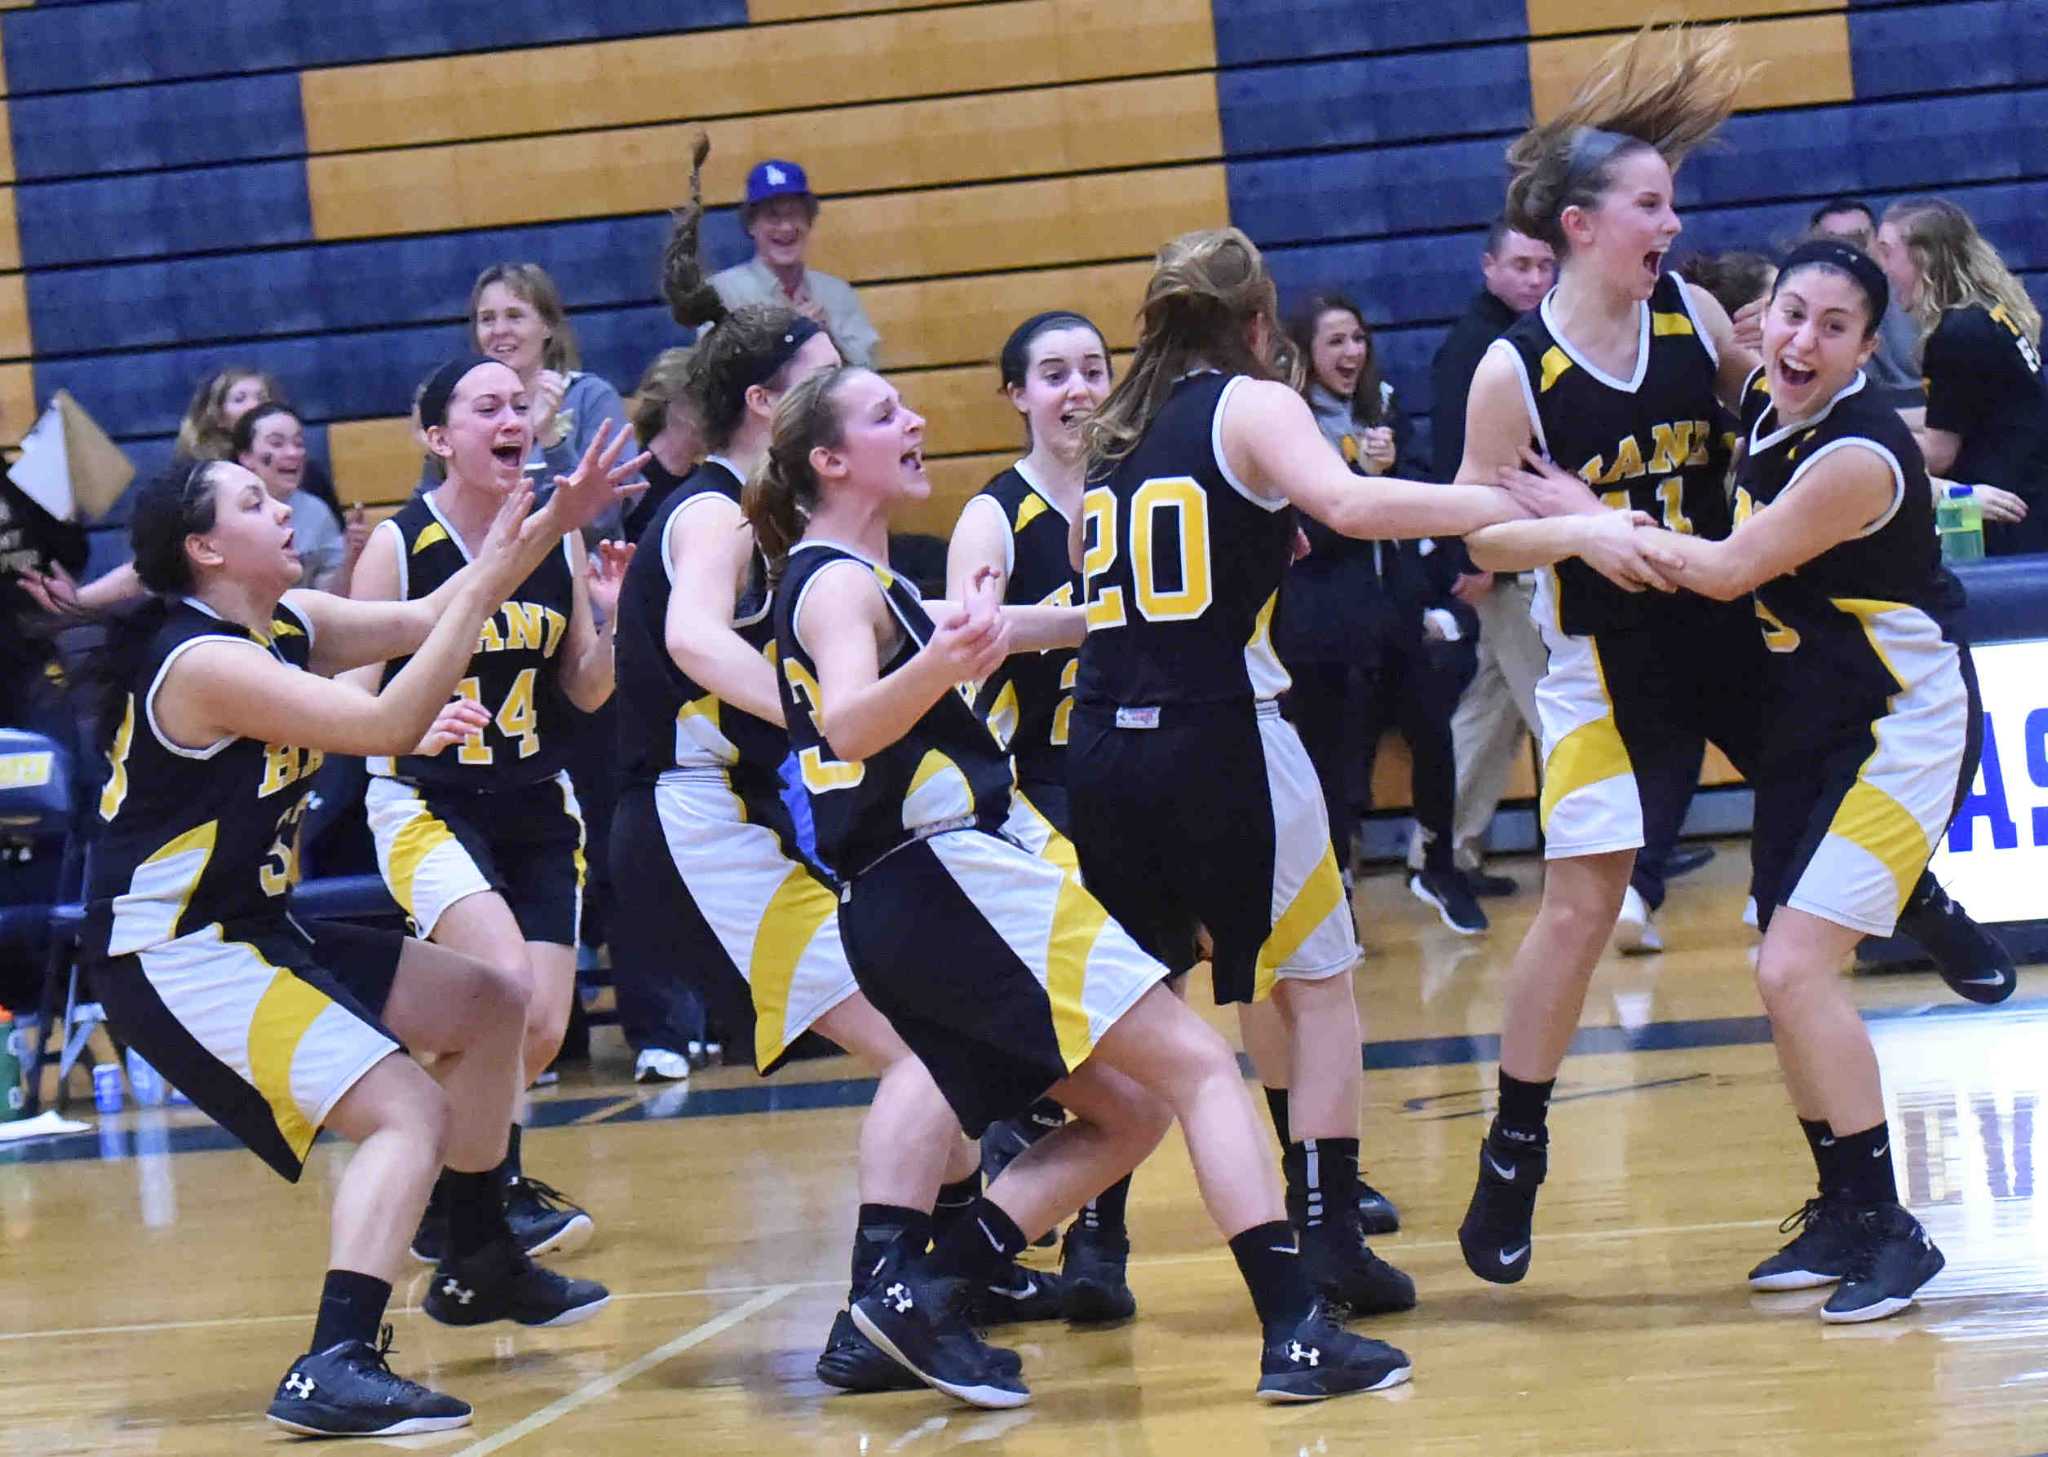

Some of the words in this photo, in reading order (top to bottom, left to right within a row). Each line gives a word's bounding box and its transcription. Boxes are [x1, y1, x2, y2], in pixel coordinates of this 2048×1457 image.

[1083, 475, 1213, 633] 20
[472, 601, 567, 659] AND
[453, 667, 541, 766] 14
